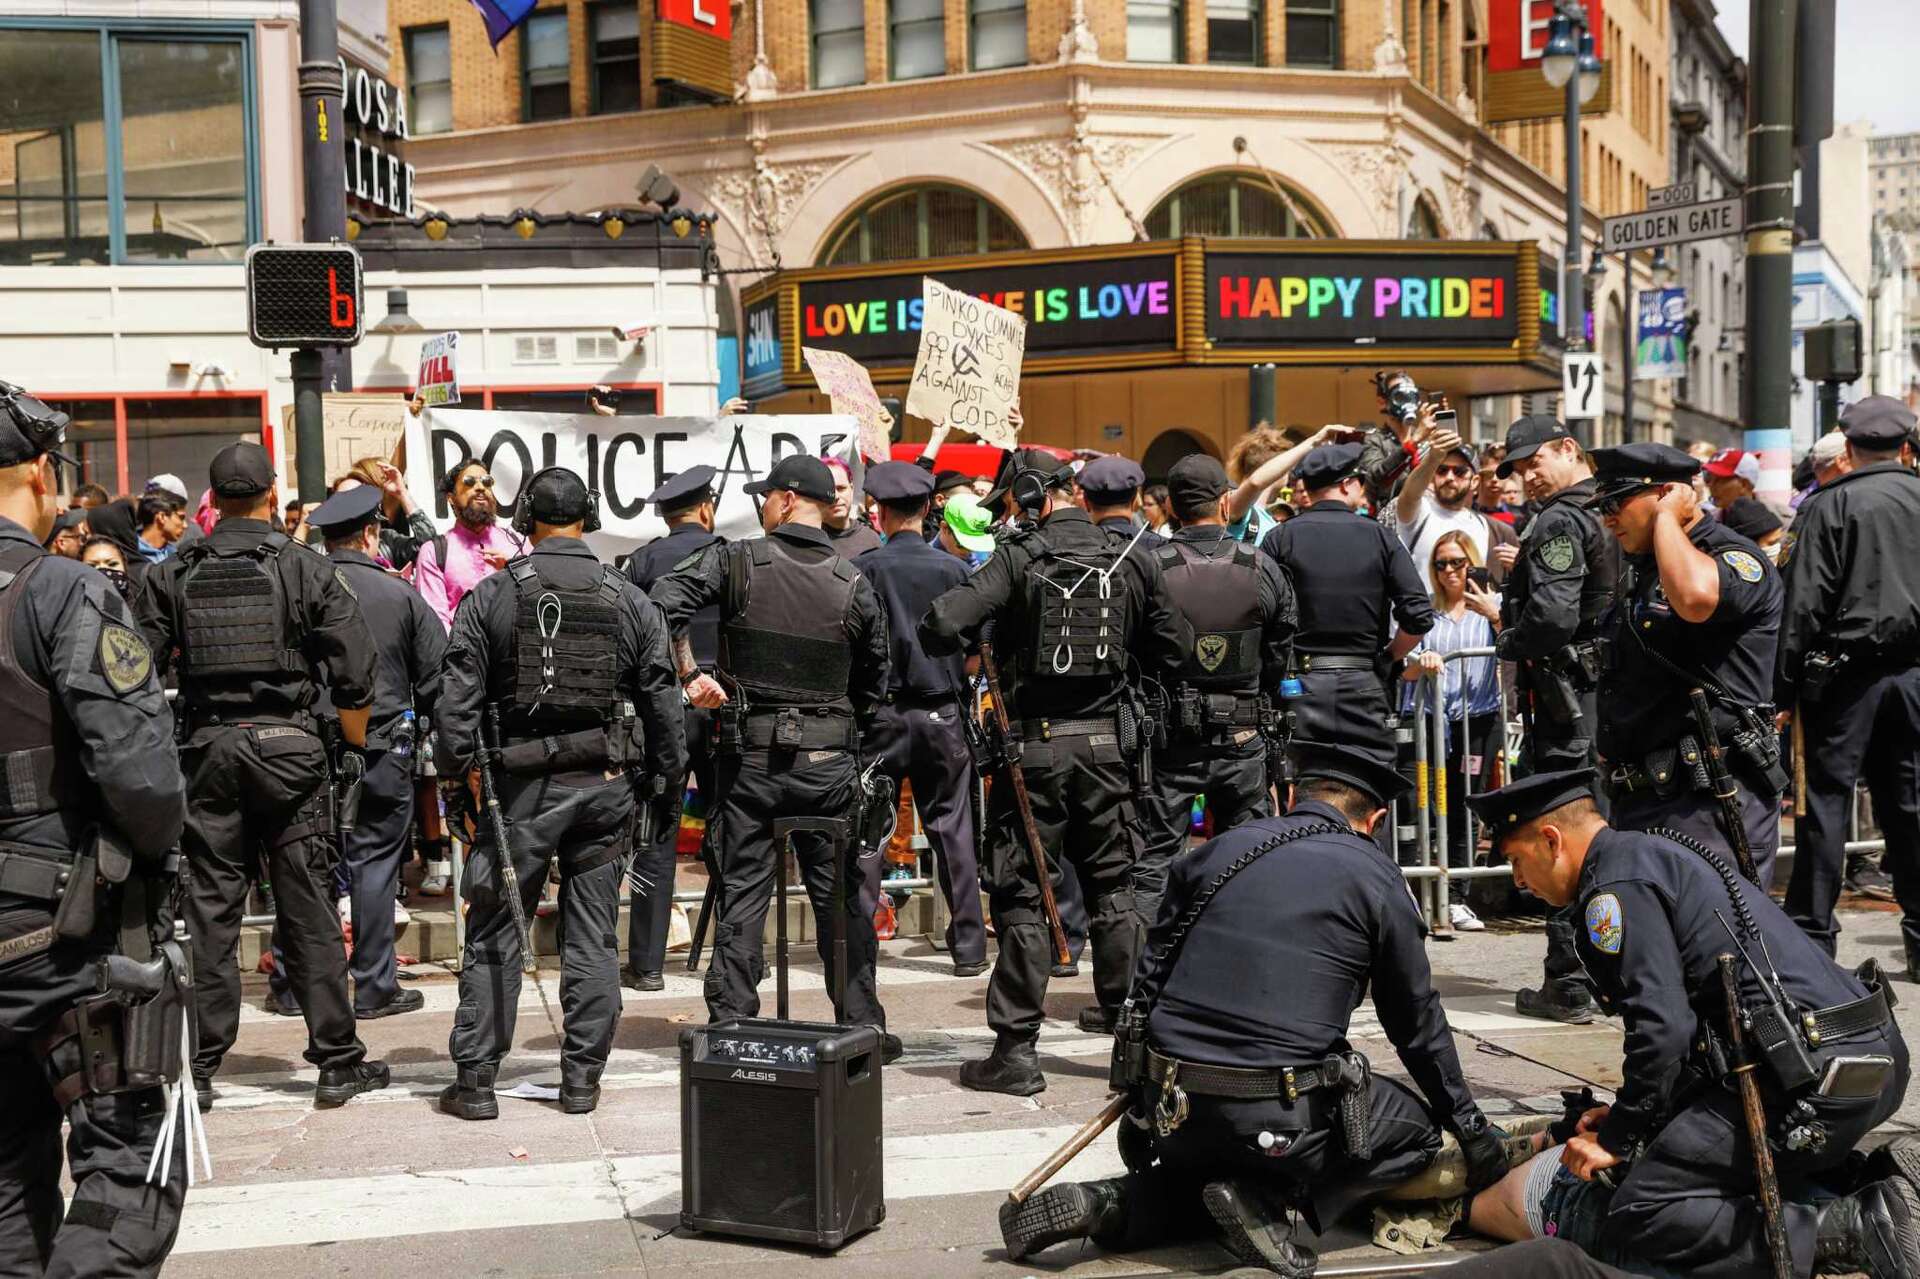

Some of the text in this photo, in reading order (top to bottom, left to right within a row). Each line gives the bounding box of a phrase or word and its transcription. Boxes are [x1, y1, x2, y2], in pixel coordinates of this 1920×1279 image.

[317, 98, 328, 143] 102
[1612, 206, 1732, 244] GOLDEN GATE
[806, 300, 888, 337] LOVE
[897, 298, 924, 331] IS
[1034, 287, 1068, 323] IS
[1079, 281, 1169, 321] LOVE
[1219, 276, 1362, 319] HAPPY
[747, 307, 775, 367] SHN
[930, 286, 978, 323] PINKO
[984, 310, 1025, 351] COMMIE
[953, 321, 1005, 361] DYKES
[420, 355, 454, 387] KILL
[916, 364, 989, 403] AGAINST
[950, 400, 1007, 439] COPS
[730, 1068, 777, 1082] ALESIS
